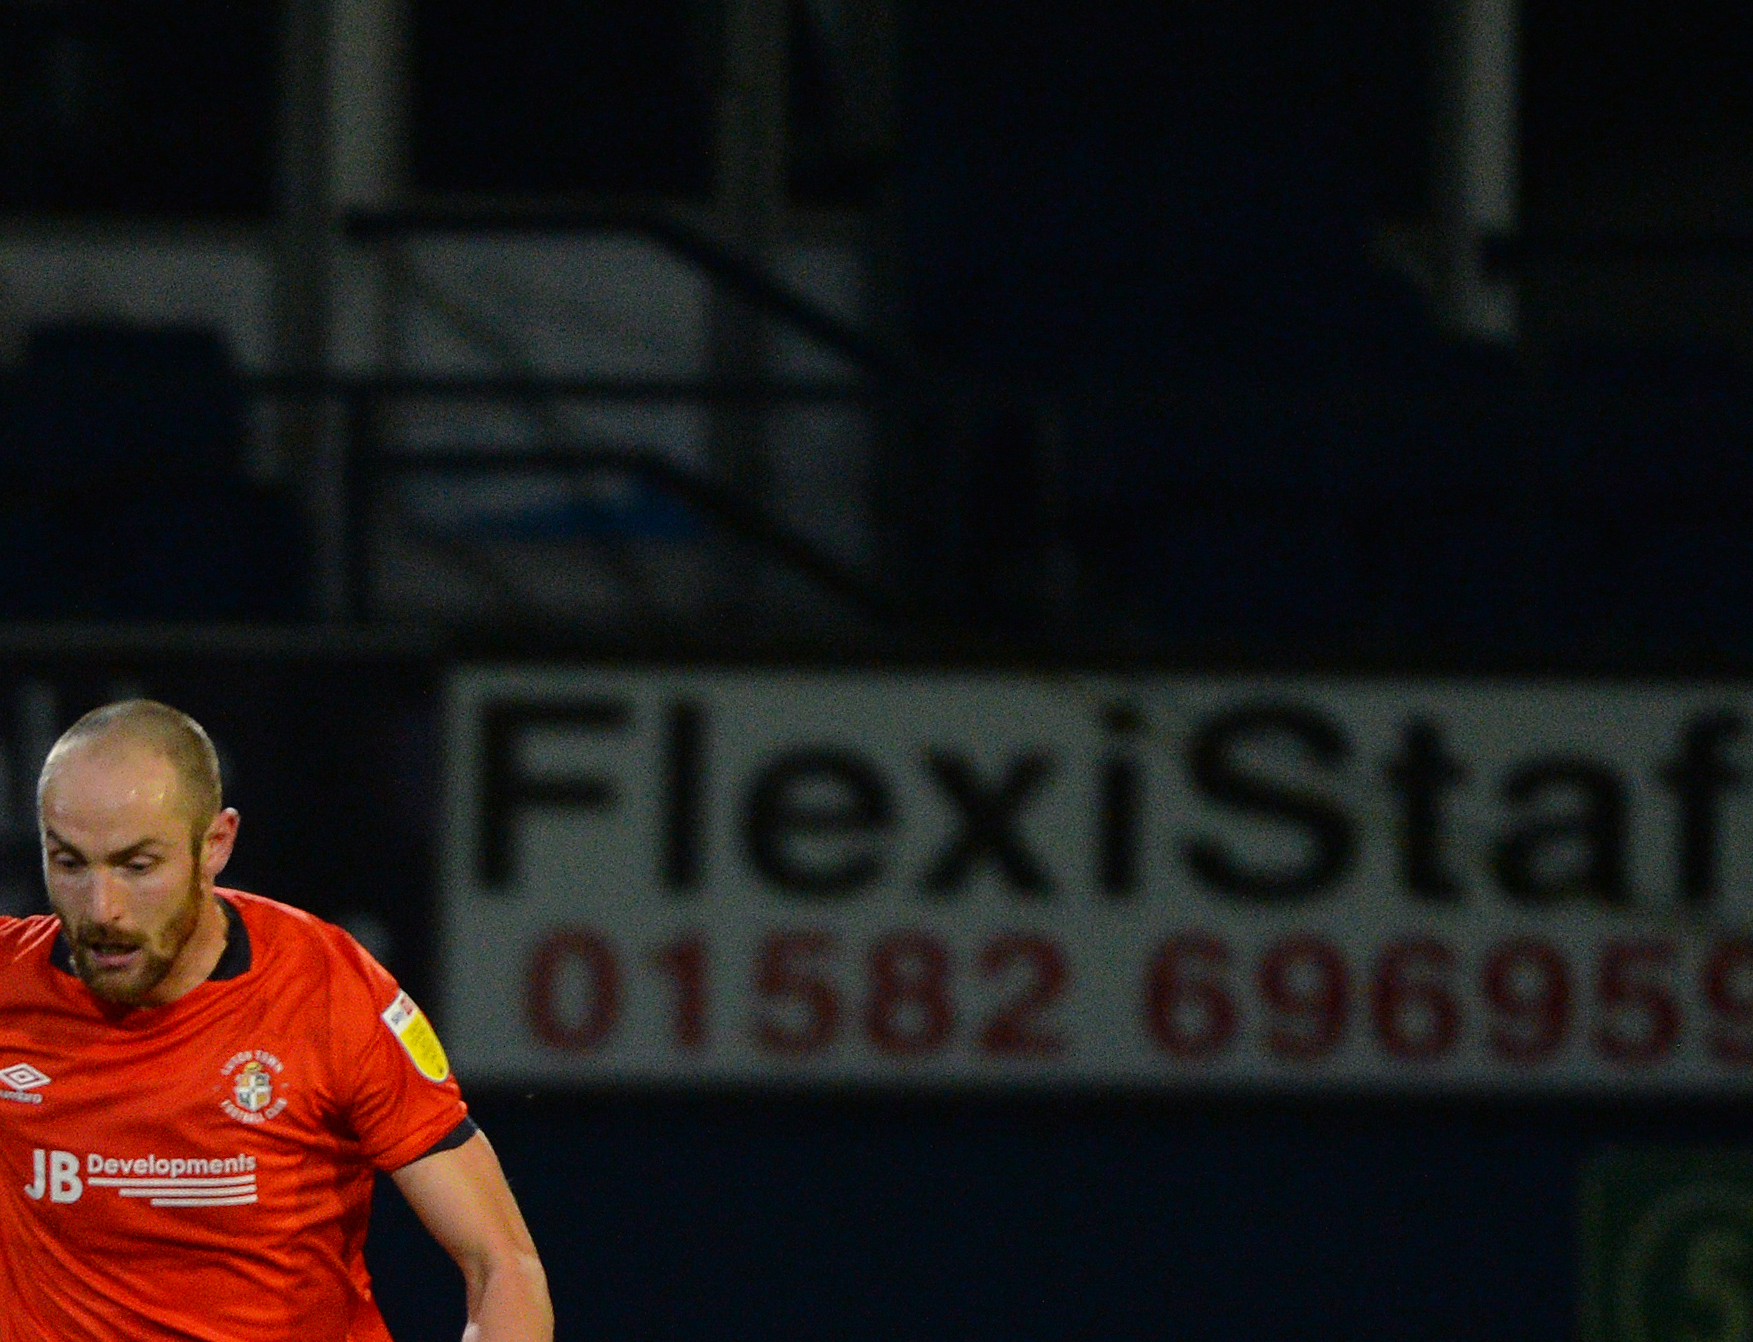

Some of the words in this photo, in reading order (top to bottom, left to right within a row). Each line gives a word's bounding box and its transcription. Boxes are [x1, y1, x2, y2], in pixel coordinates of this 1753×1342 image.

[472, 694, 1745, 902] FlexiStaf
[523, 926, 1072, 1060] 01582
[24, 1148, 83, 1204] JB
[87, 1152, 256, 1178] Developments
